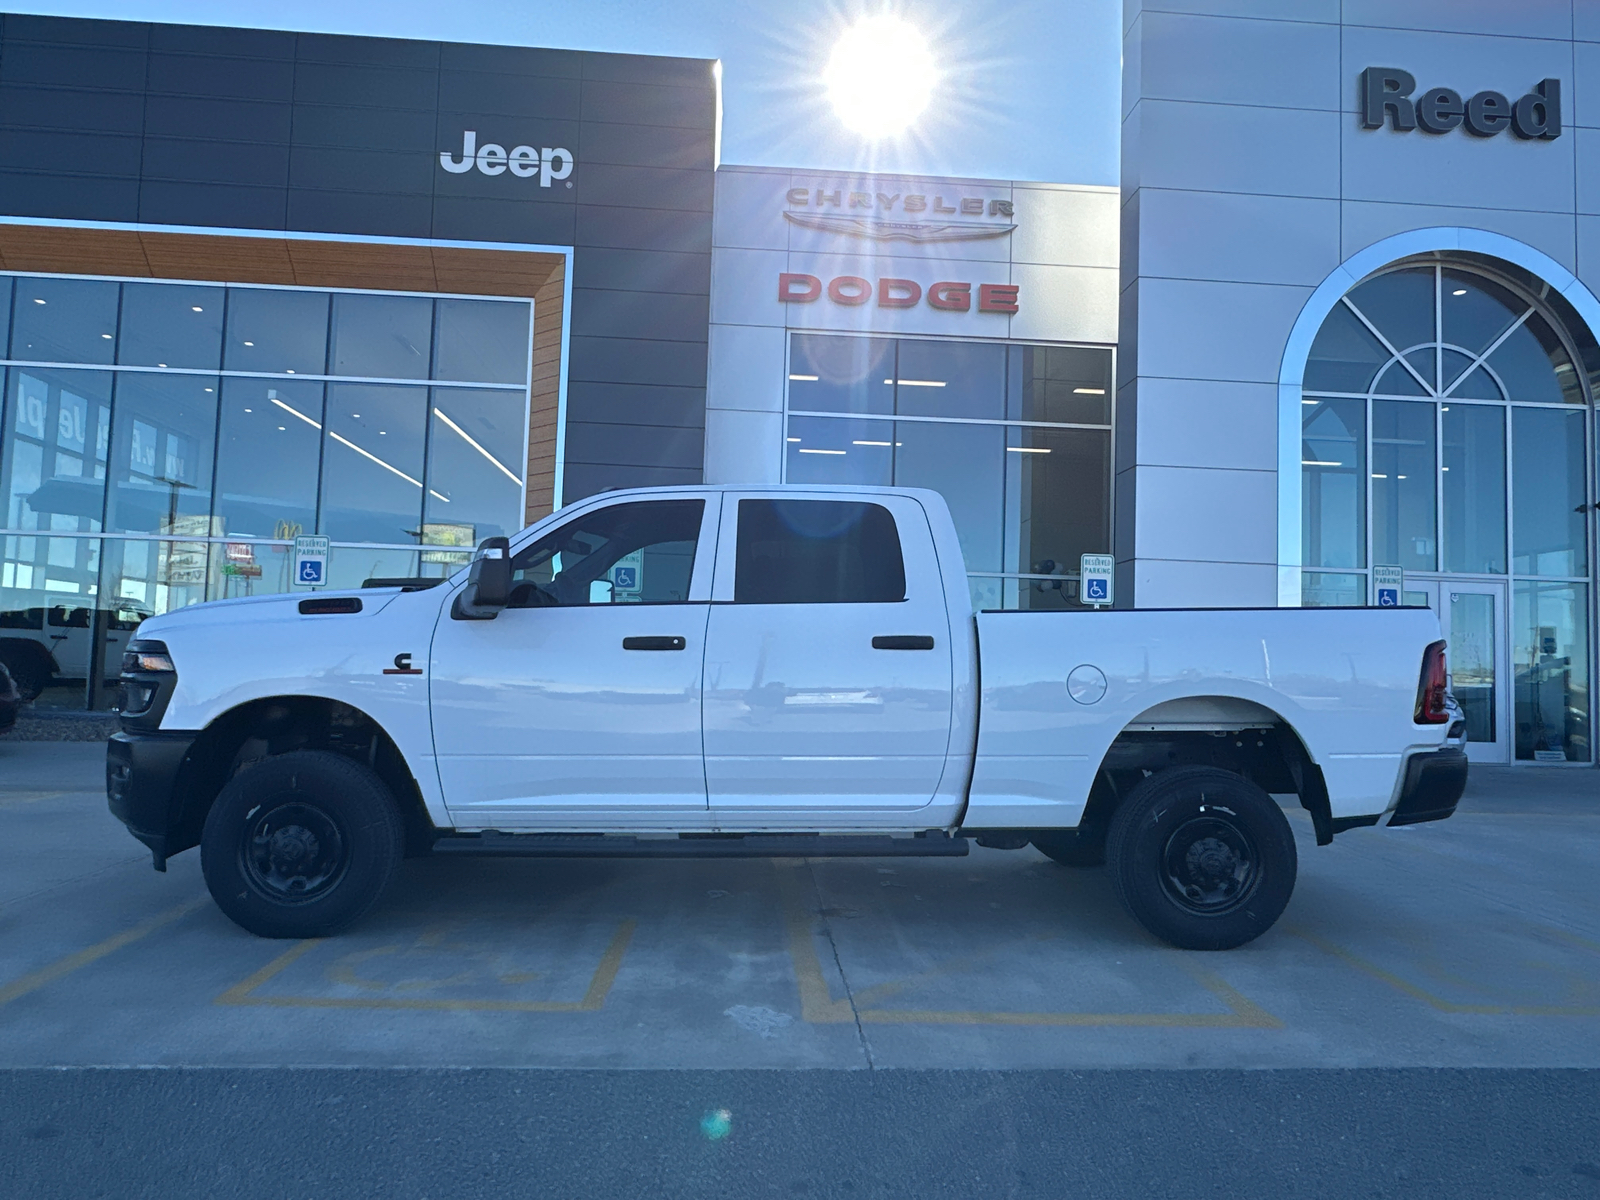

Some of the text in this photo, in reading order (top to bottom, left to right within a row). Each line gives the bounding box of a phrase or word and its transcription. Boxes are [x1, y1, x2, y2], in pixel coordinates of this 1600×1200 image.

[1362, 67, 1562, 140] Reed
[440, 131, 574, 188] Jeep
[786, 188, 1015, 216] CHRYSLER
[778, 272, 1020, 315] DODGE
[298, 539, 326, 547] RESERVED
[1084, 558, 1111, 566] RESERVED
